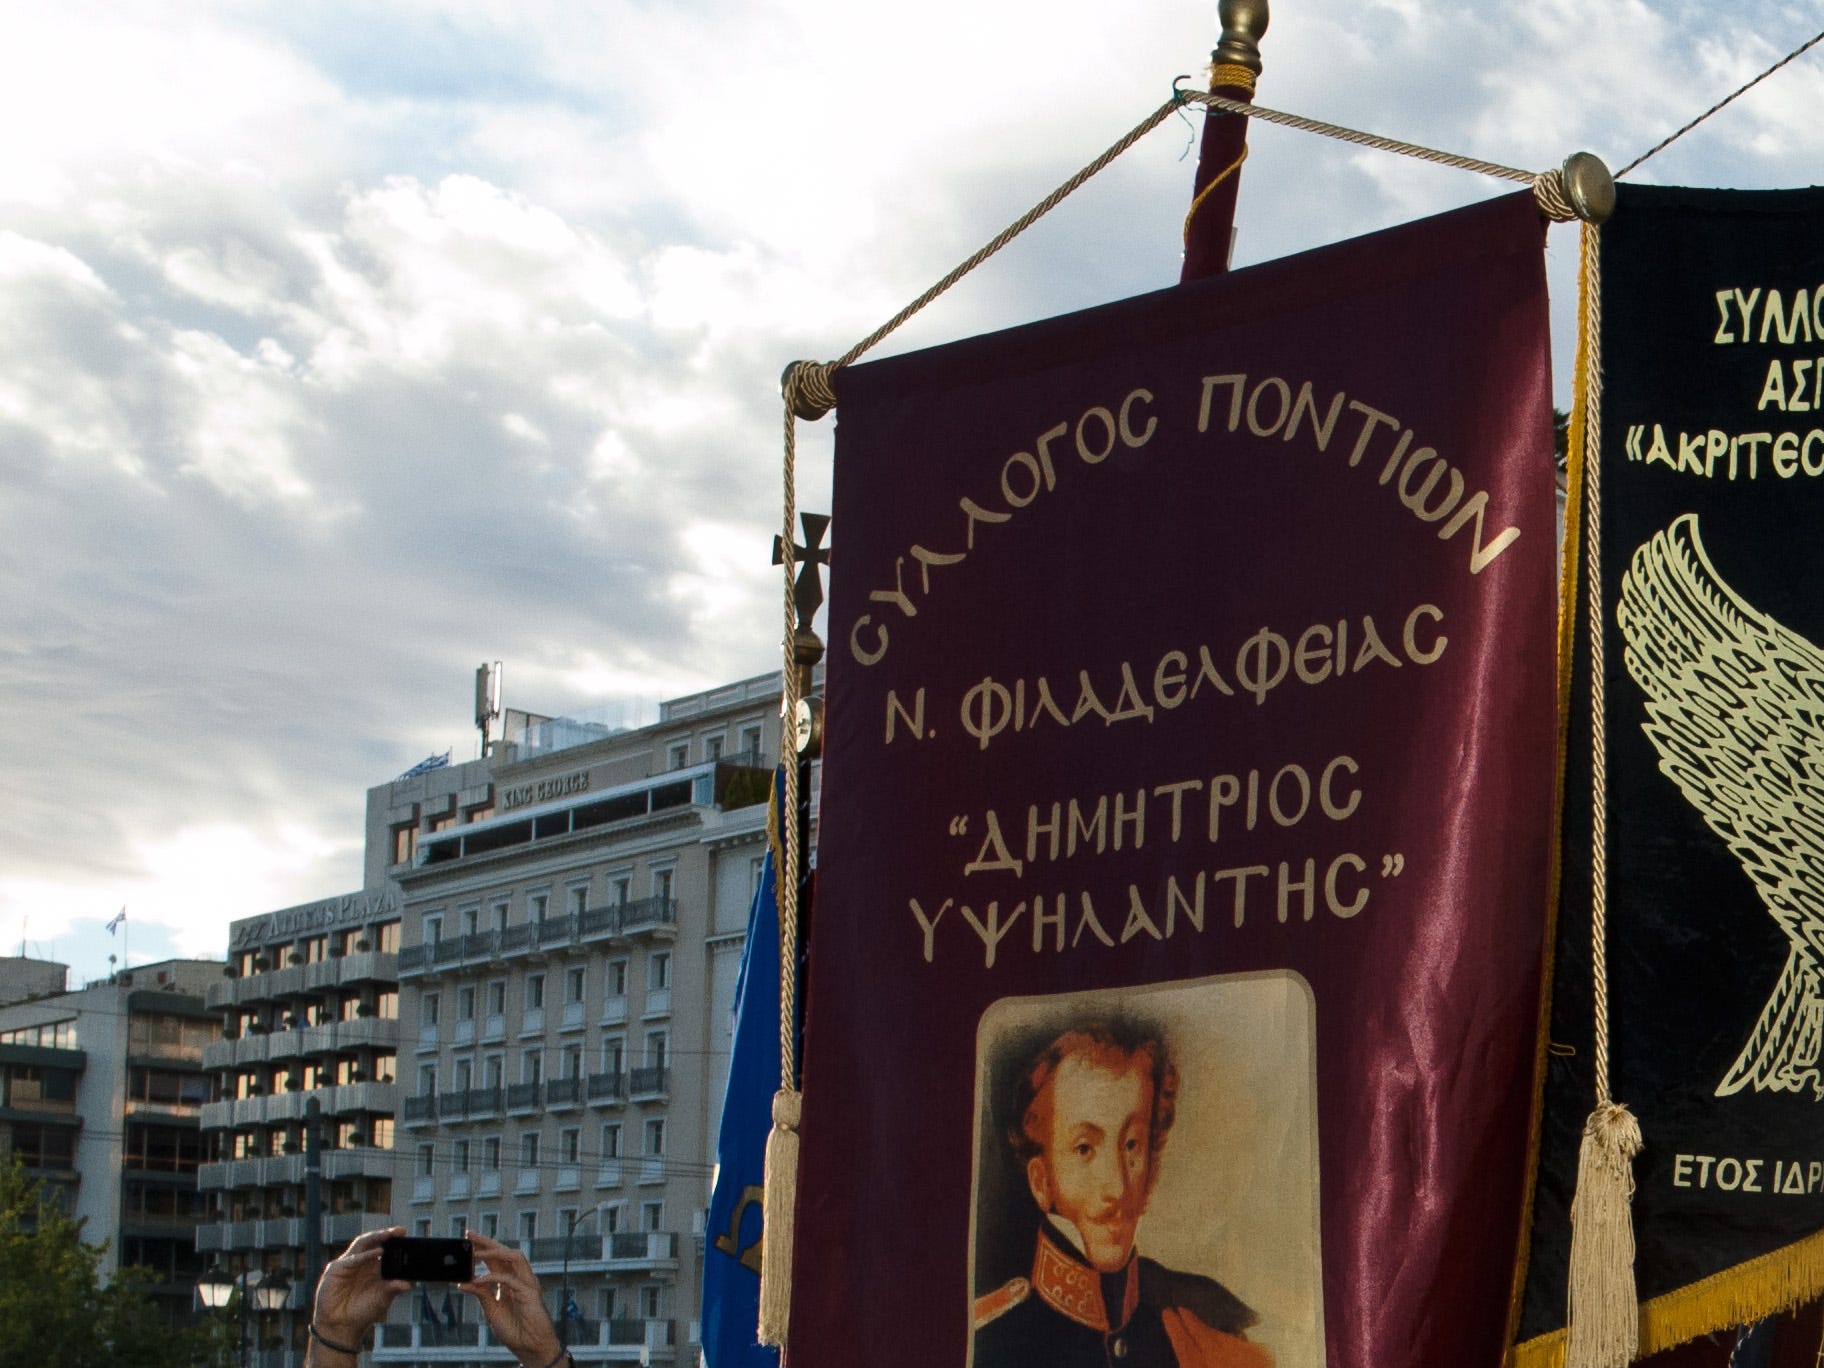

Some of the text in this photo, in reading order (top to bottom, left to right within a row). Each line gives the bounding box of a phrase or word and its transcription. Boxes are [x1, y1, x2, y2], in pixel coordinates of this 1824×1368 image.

[1197, 373, 1521, 574] ΠΟΝΤΙΩΝ
[536, 770, 590, 802] GEORGE
[1673, 1153, 1764, 1193] ΕΤΟΣ
